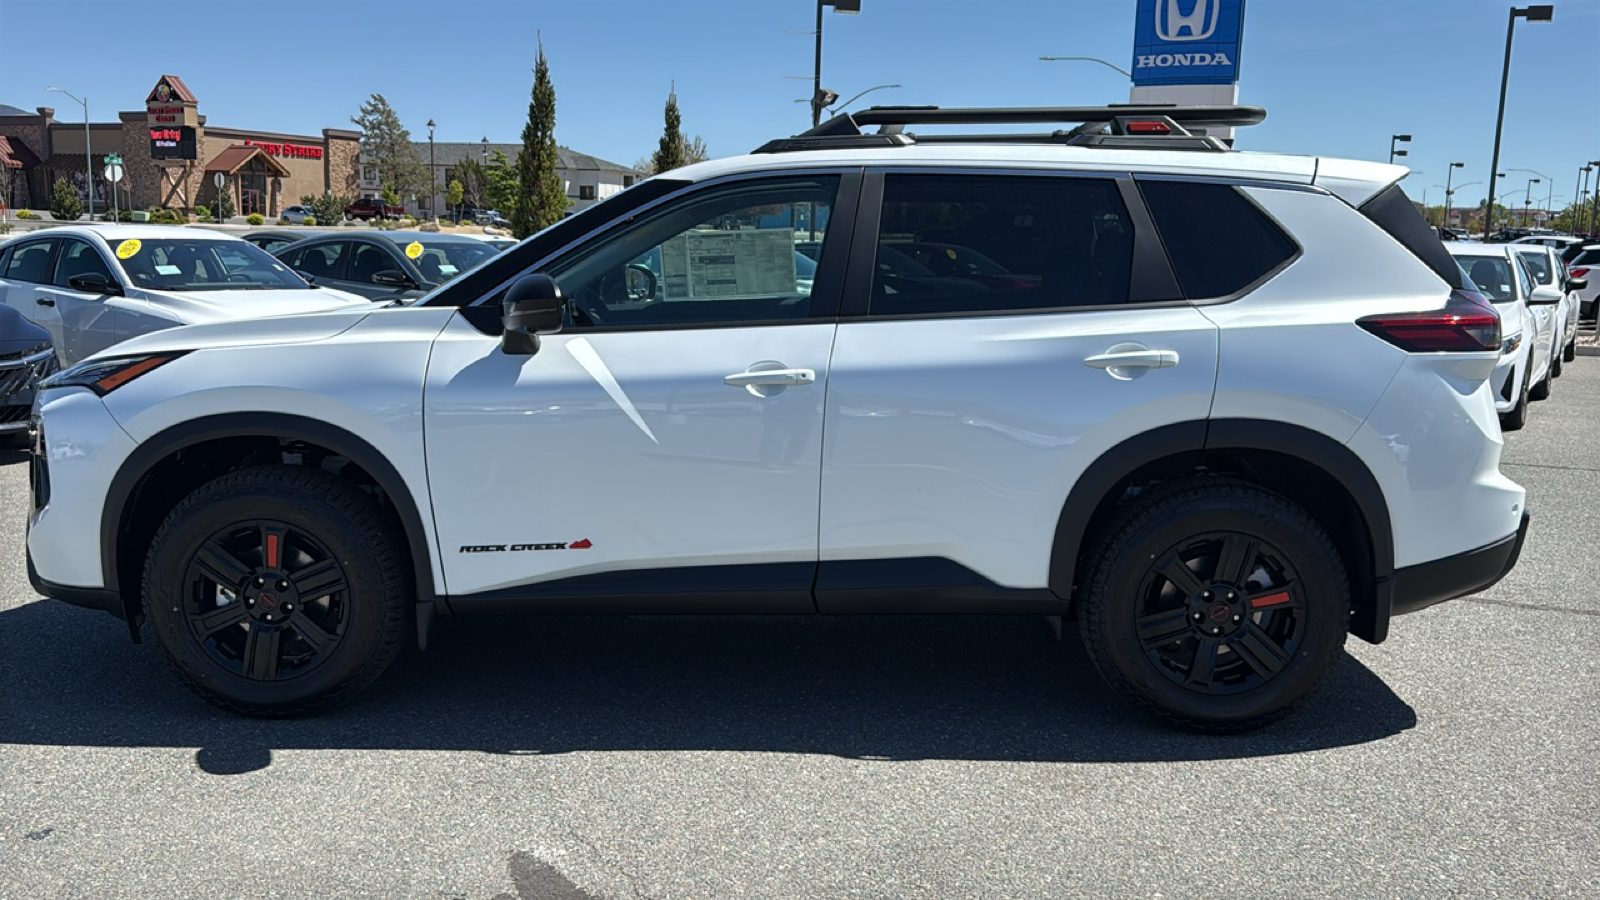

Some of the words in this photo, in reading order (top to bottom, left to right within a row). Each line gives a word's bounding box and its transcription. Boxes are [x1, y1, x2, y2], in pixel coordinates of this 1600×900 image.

[1136, 52, 1232, 68] HONDA
[284, 141, 323, 157] STRIKE
[459, 544, 507, 553] ROCK
[510, 542, 568, 551] CREEK
